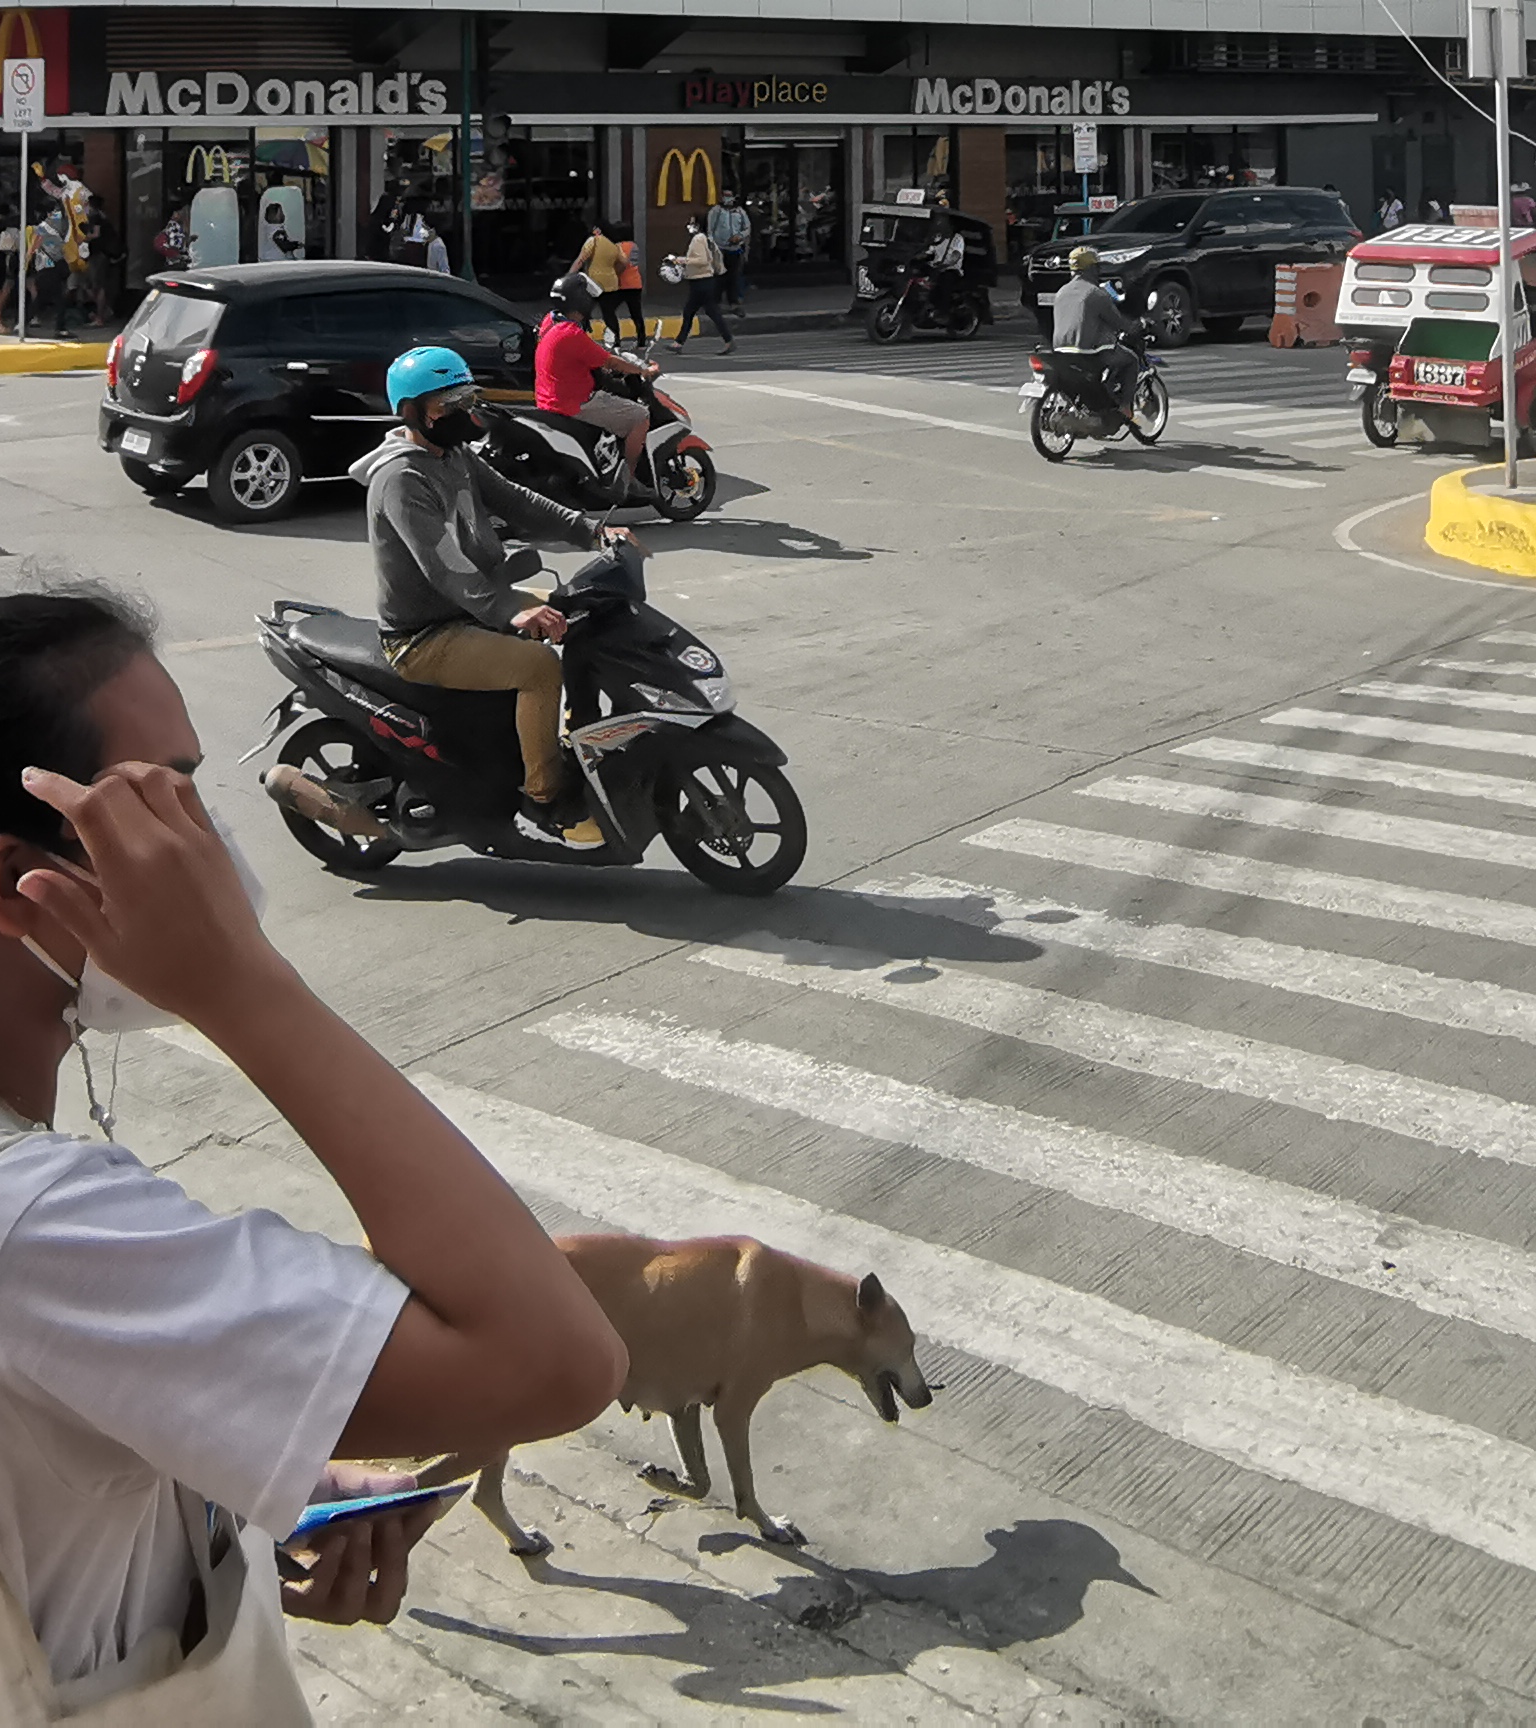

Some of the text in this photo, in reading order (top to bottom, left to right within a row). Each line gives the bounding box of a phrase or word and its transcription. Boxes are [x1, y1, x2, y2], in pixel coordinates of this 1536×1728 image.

[106, 71, 447, 115] McDonald's
[914, 78, 1131, 115] McDonald's
[1418, 362, 1464, 386] 1337
